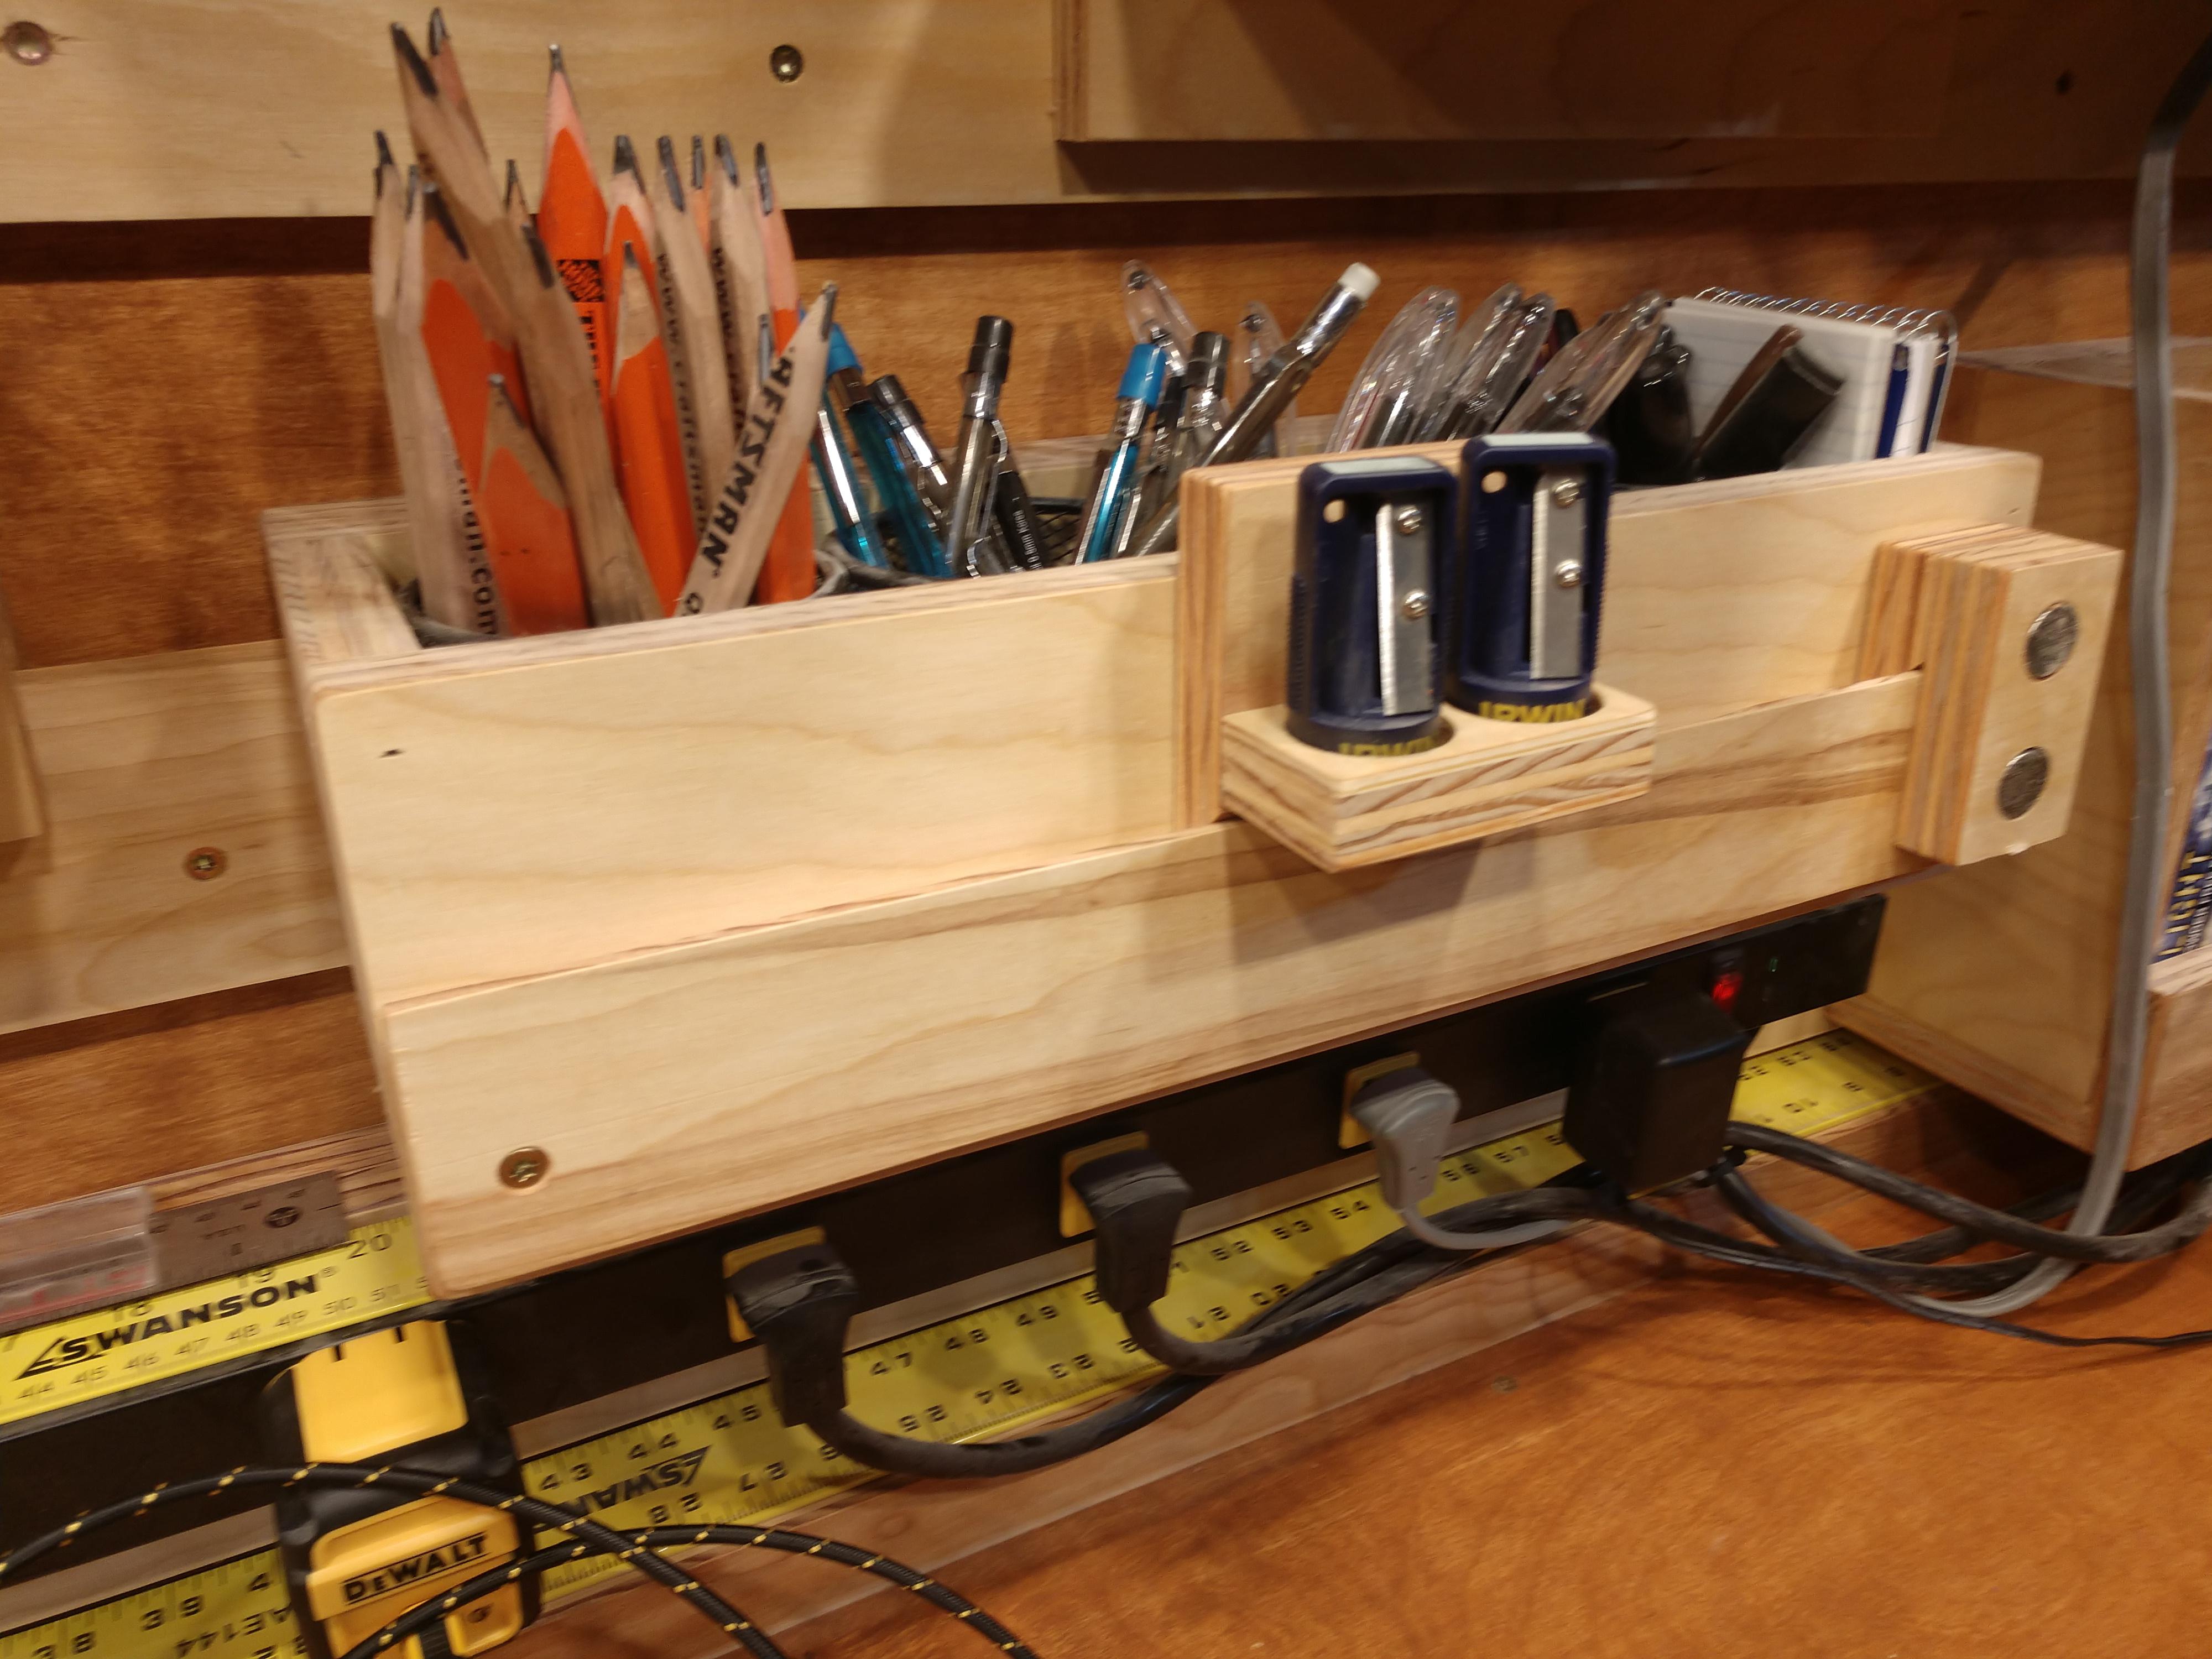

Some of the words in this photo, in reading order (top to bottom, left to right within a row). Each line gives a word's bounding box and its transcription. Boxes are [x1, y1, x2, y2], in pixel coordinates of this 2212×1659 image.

[701, 348, 795, 571] AFTSMAN
[346, 1233, 393, 1260] 20
[61, 1274, 318, 1361] SWANSON
[70, 1364, 109, 1384] 45
[122, 1351, 160, 1370] 46
[173, 1337, 211, 1356] 47
[224, 1323, 261, 1342] 48
[275, 1310, 310, 1328] 49
[322, 1295, 358, 1316] 50
[1048, 1353, 1095, 1379] 23
[974, 1379, 1023, 1405] 24
[898, 1404, 948, 1433] 25
[140, 1595, 204, 1631] 39
[540, 1463, 592, 1492] 43
[628, 1432, 679, 1460] 44
[713, 1404, 762, 1431] 45
[870, 1351, 913, 1376] 47
[945, 1328, 990, 1351] 48
[1016, 1305, 1060, 1326] 49
[738, 1460, 788, 1493] 27
[648, 1492, 703, 1525] 28
